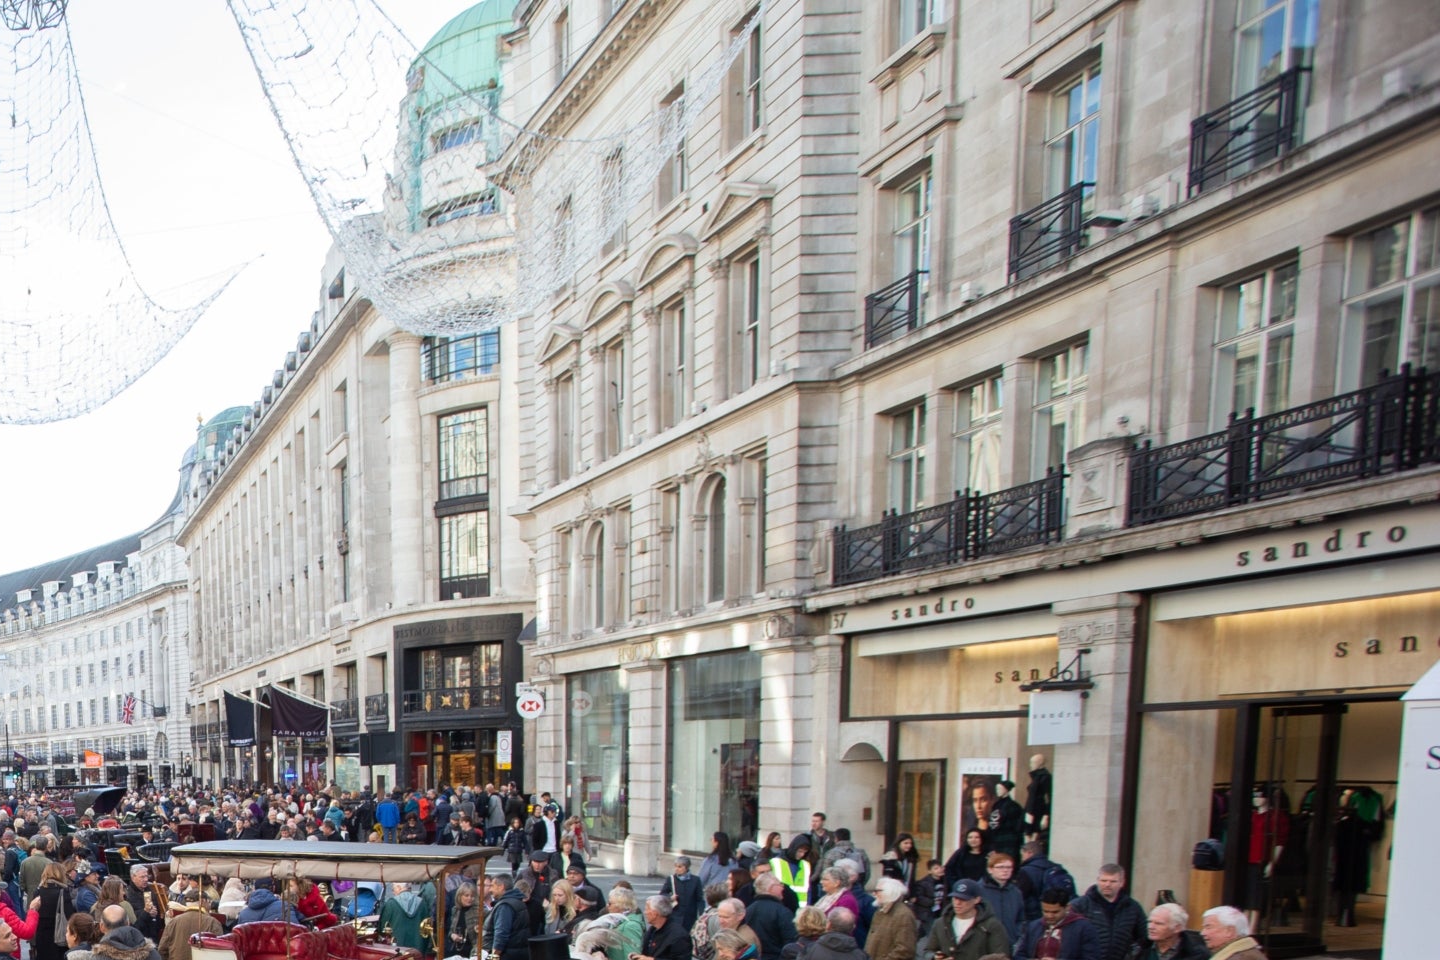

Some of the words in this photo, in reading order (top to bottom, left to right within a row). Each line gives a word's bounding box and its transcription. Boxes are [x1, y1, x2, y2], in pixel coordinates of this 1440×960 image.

[1236, 525, 1407, 566] sandro
[891, 597, 976, 620] sandro
[1335, 632, 1440, 658] san
[1033, 710, 1080, 719] sandro
[272, 729, 296, 737] ZARA
[299, 729, 326, 737] HOME
